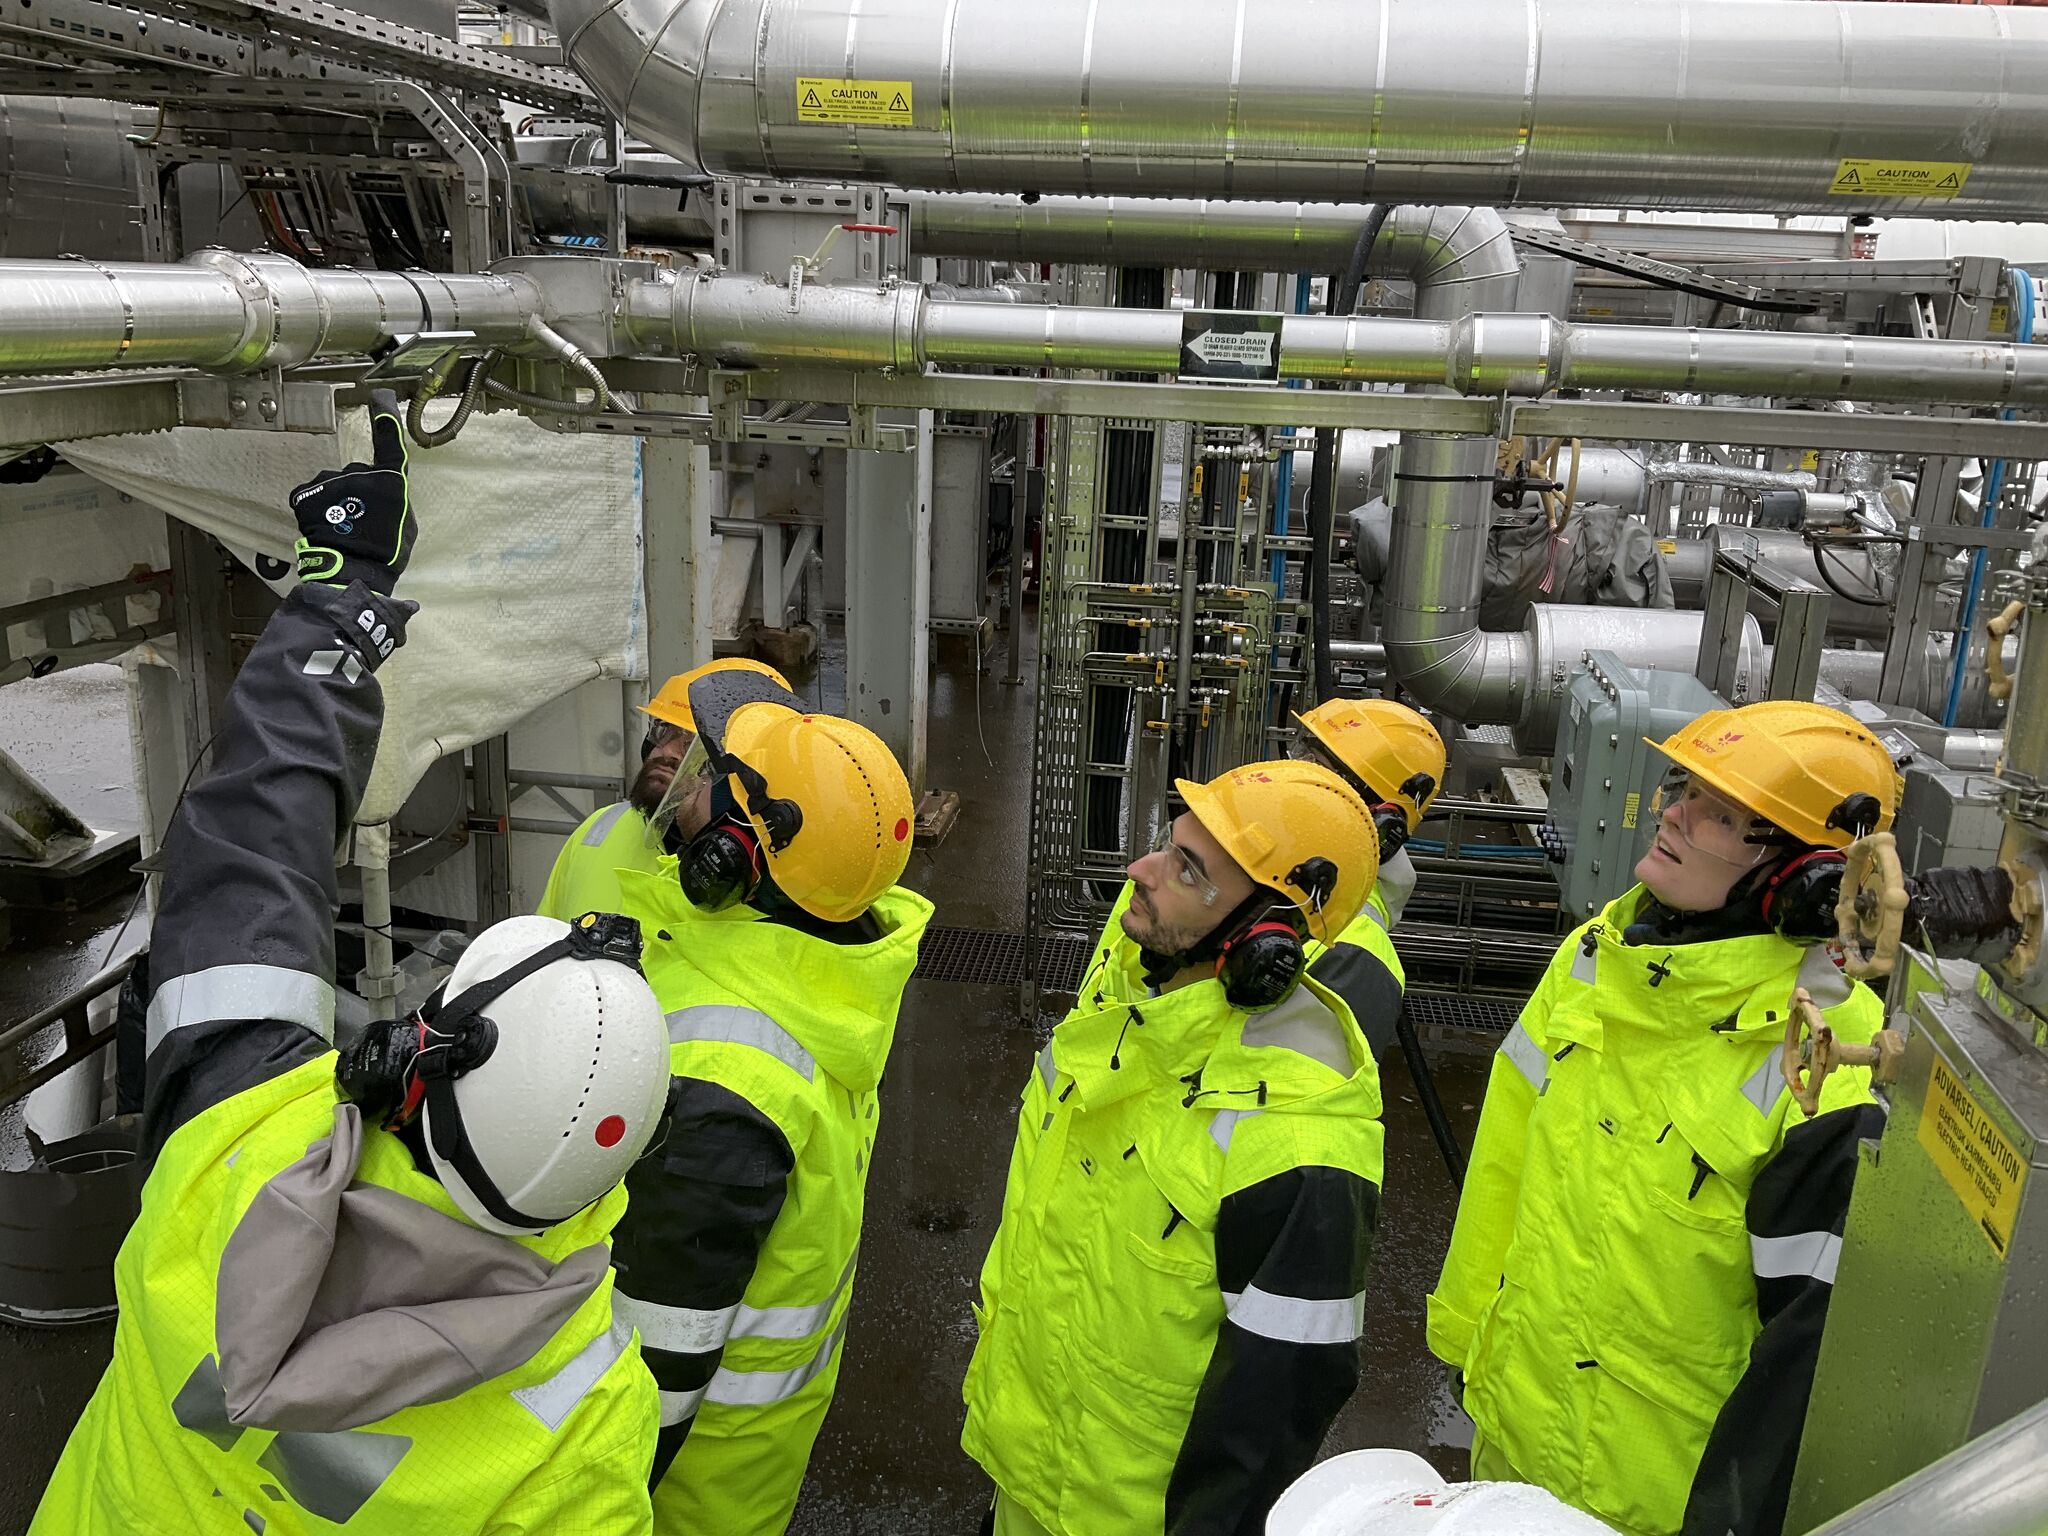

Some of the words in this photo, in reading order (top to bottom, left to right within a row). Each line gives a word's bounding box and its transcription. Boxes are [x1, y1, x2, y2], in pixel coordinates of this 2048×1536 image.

[832, 89, 878, 99] CAUTION
[1877, 169, 1930, 179] CAUTION
[1204, 336, 1237, 344] CLOSED
[1240, 337, 1267, 346] DRAIN
[1937, 1122, 1961, 1160] ELECTRIC
[1960, 1153, 1974, 1178] HEAT
[1974, 1171, 1998, 1208] TRACED
[1938, 1103, 1965, 1147] ELEKTRISK
[1965, 1139, 2002, 1195] VARMEKABEL
[1979, 1121, 2020, 1184] CAUTION
